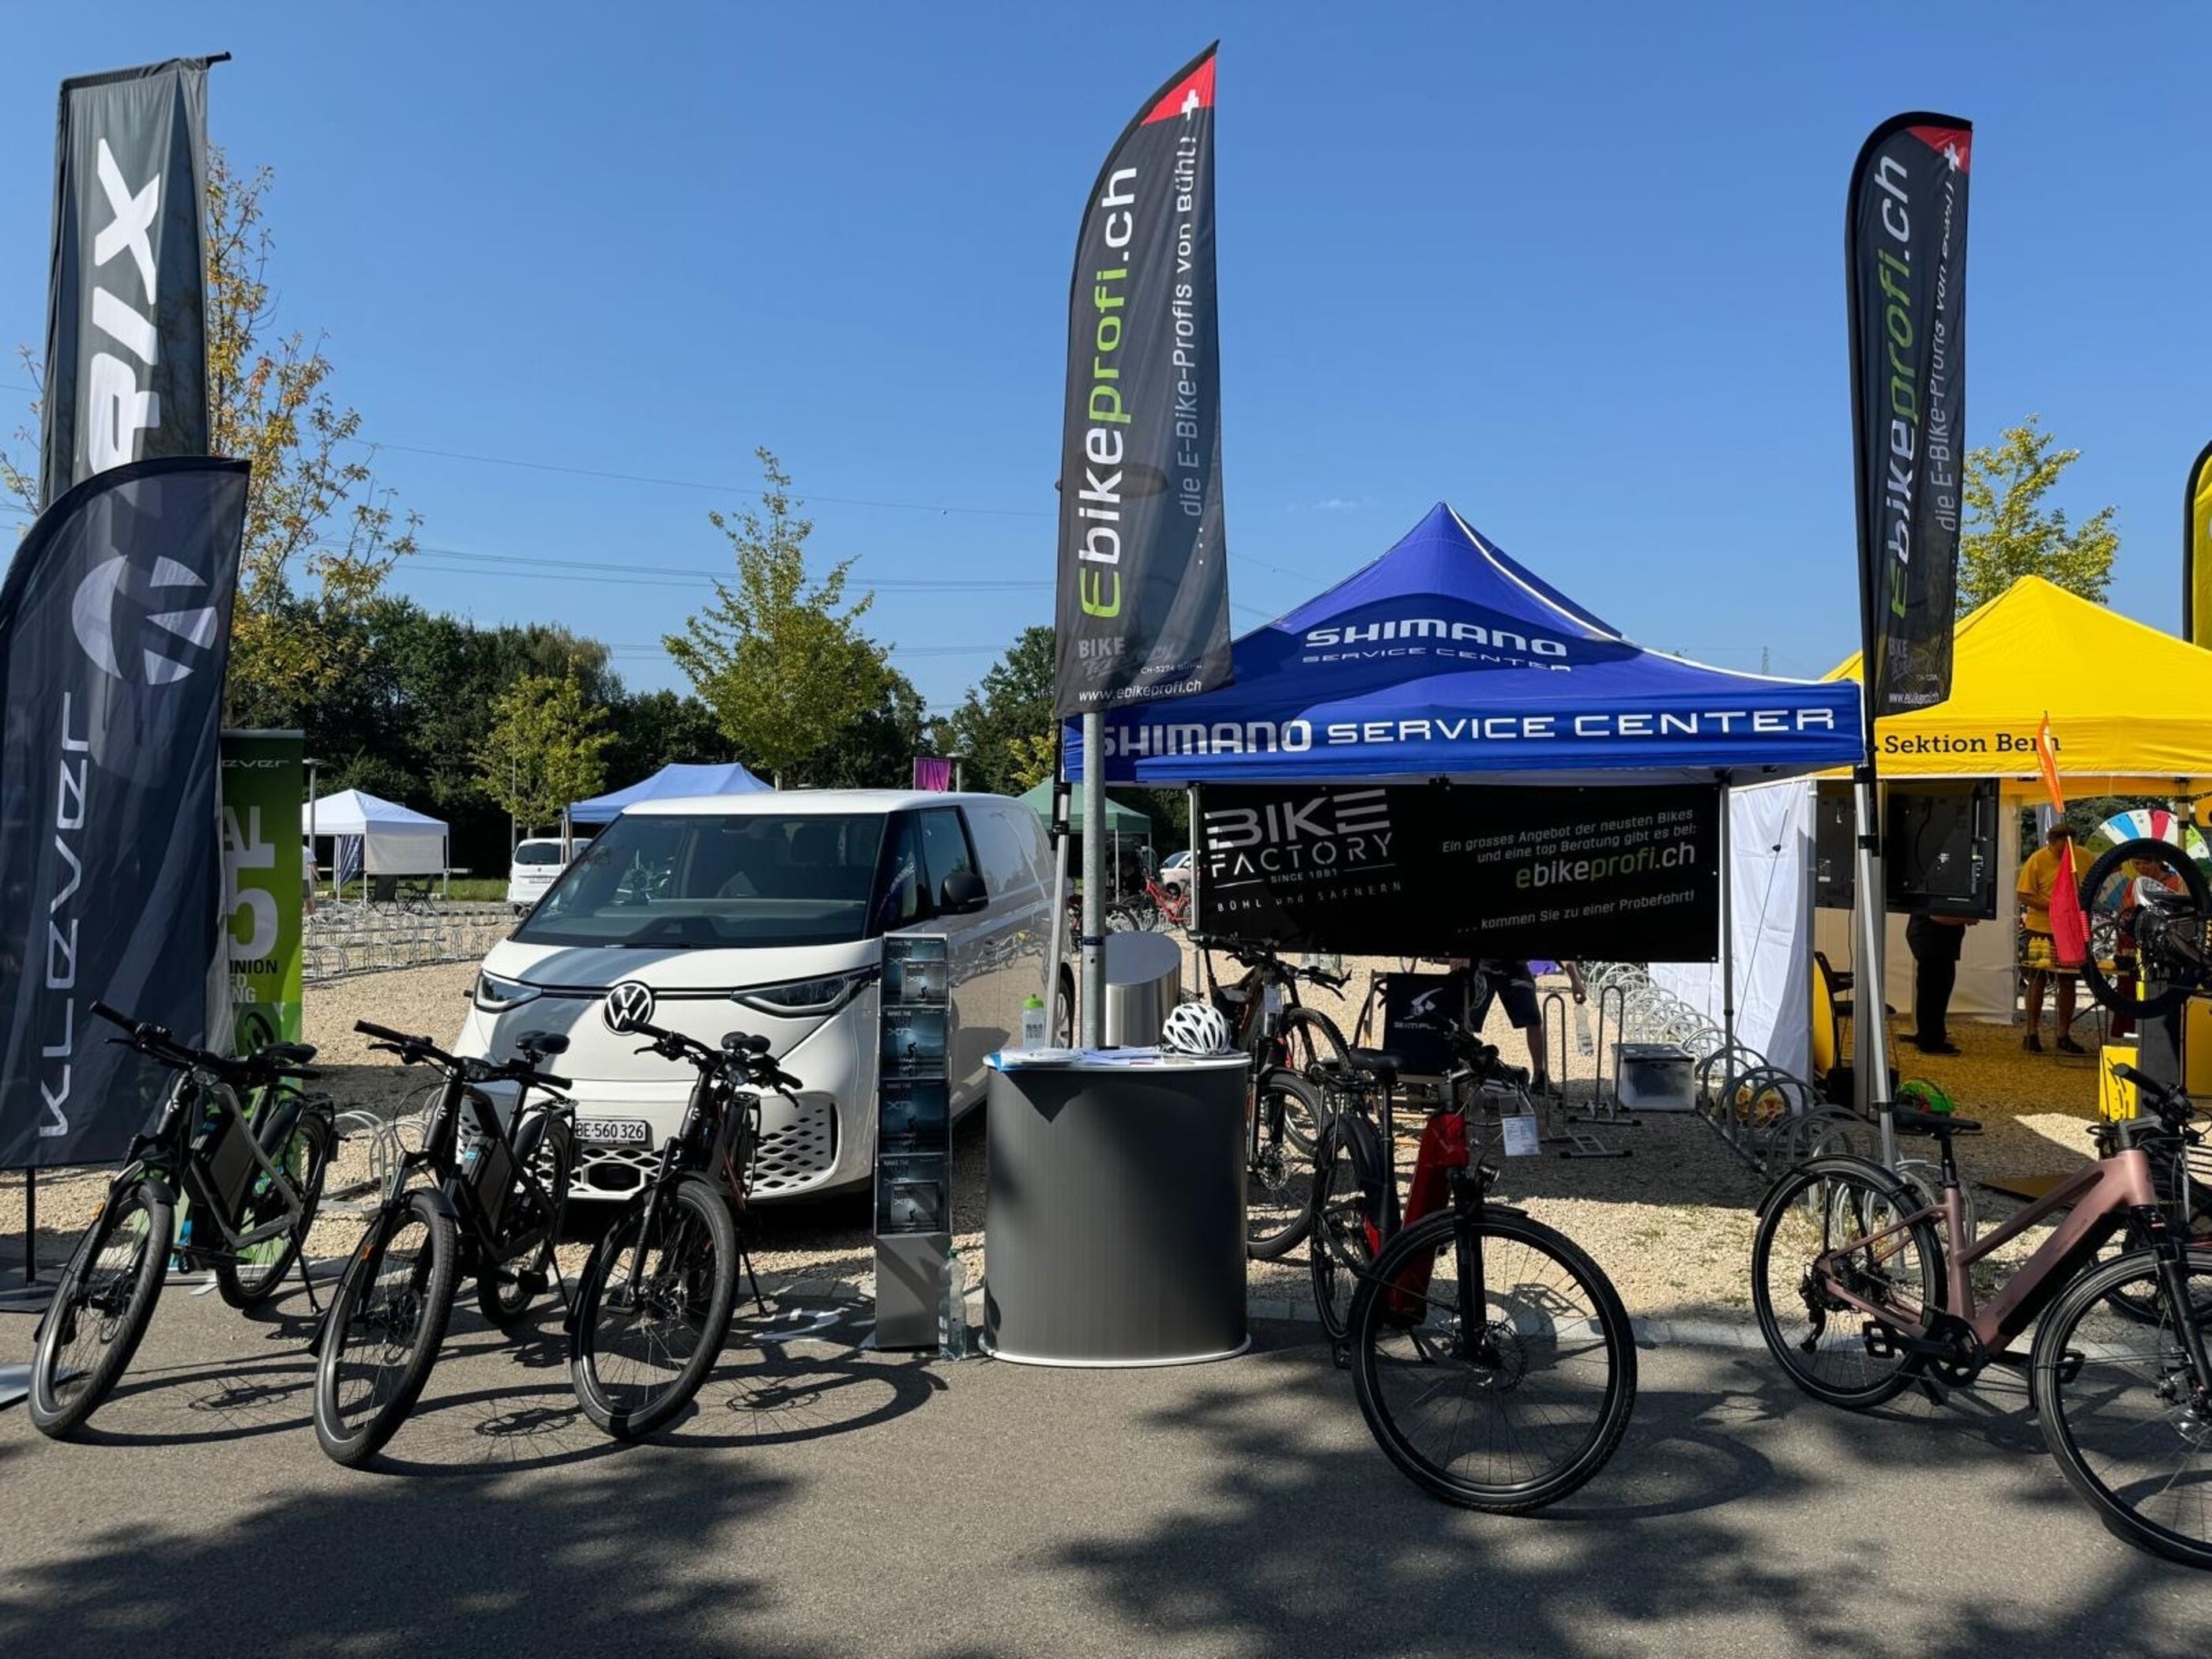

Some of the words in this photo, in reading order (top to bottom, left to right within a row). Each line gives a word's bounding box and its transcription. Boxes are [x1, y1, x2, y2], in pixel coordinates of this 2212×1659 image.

[1174, 137, 1197, 213] Bühl!
[1176, 223, 1192, 274] von
[88, 137, 160, 474] RIX
[1172, 284, 1200, 469] E-Bike-Profis
[1179, 476, 1202, 517] die
[1935, 495, 1956, 532] die
[1078, 636, 1126, 660] BIKE
[1305, 618, 1568, 658] SHIMANO
[1301, 647, 1427, 664] SERVICE
[1435, 647, 1572, 672] CENTER
[1078, 679, 1203, 703] www.ebikeprofi.ch
[1327, 716, 1556, 746] SERVICE
[1574, 707, 1836, 738] CENTER
[1884, 734, 1988, 754] Sektion
[220, 759, 291, 769] EVER
[222, 805, 276, 852] AL
[1204, 788, 1391, 851] BIKE
[1442, 840, 1462, 853] Ein
[1465, 833, 1515, 852] grosses
[1518, 825, 1571, 843] Angebot
[1575, 822, 1597, 836] der
[1600, 814, 1653, 833] neusten
[1657, 808, 1694, 824] Bikes
[1209, 831, 1393, 878] FACTORY
[1477, 849, 1502, 863] und
[1504, 846, 1533, 860] eine
[1536, 843, 1557, 856] top
[1560, 834, 1620, 852] Beratung
[1623, 830, 1650, 846] gibt
[1653, 827, 1670, 840] es
[1270, 871, 1304, 884] SINCE
[1514, 841, 1696, 890] ebikeprofi.ch
[1275, 894, 1304, 906] und
[1540, 910, 1560, 923] Sie
[1563, 907, 1579, 920] zu
[1582, 901, 1616, 916] einer
[1620, 889, 1695, 911] Probefahrt!
[229, 959, 278, 974] INION
[620, 1123, 644, 1139] 326
